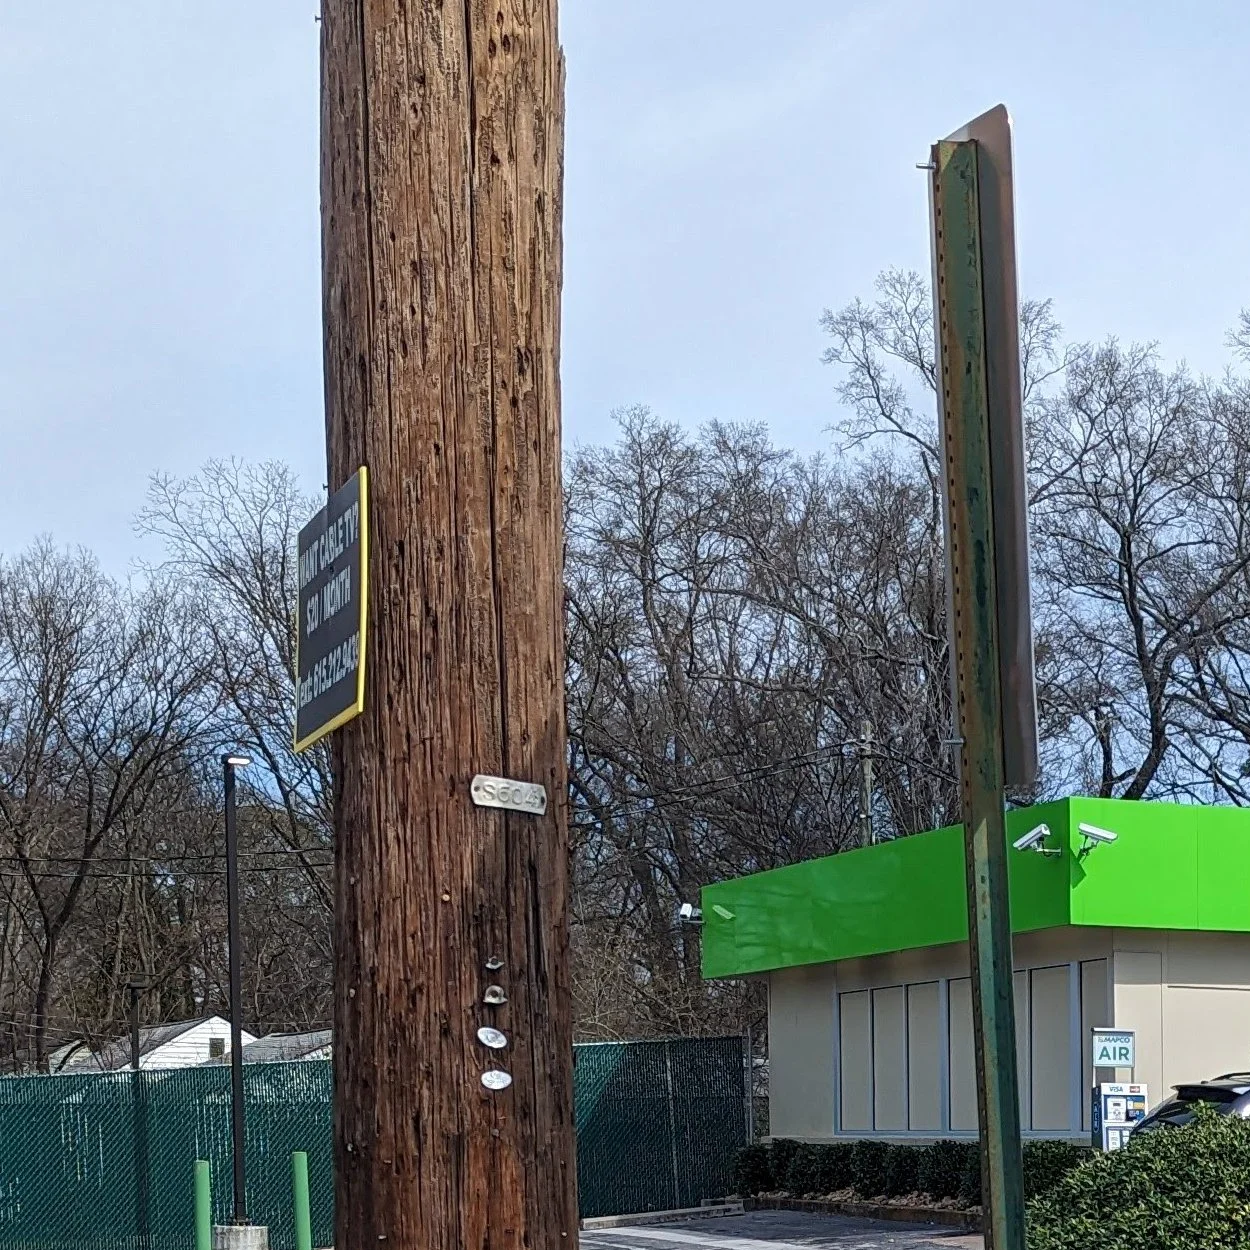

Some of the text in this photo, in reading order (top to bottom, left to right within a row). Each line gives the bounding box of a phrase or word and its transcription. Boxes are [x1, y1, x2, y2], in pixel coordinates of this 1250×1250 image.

[300, 500, 359, 590] WANT CABLE TV?
[306, 592, 319, 639] $20
[323, 565, 351, 621] MONTH
[1098, 1046, 1130, 1061] AIR
[1104, 1035, 1131, 1043] MAPCO
